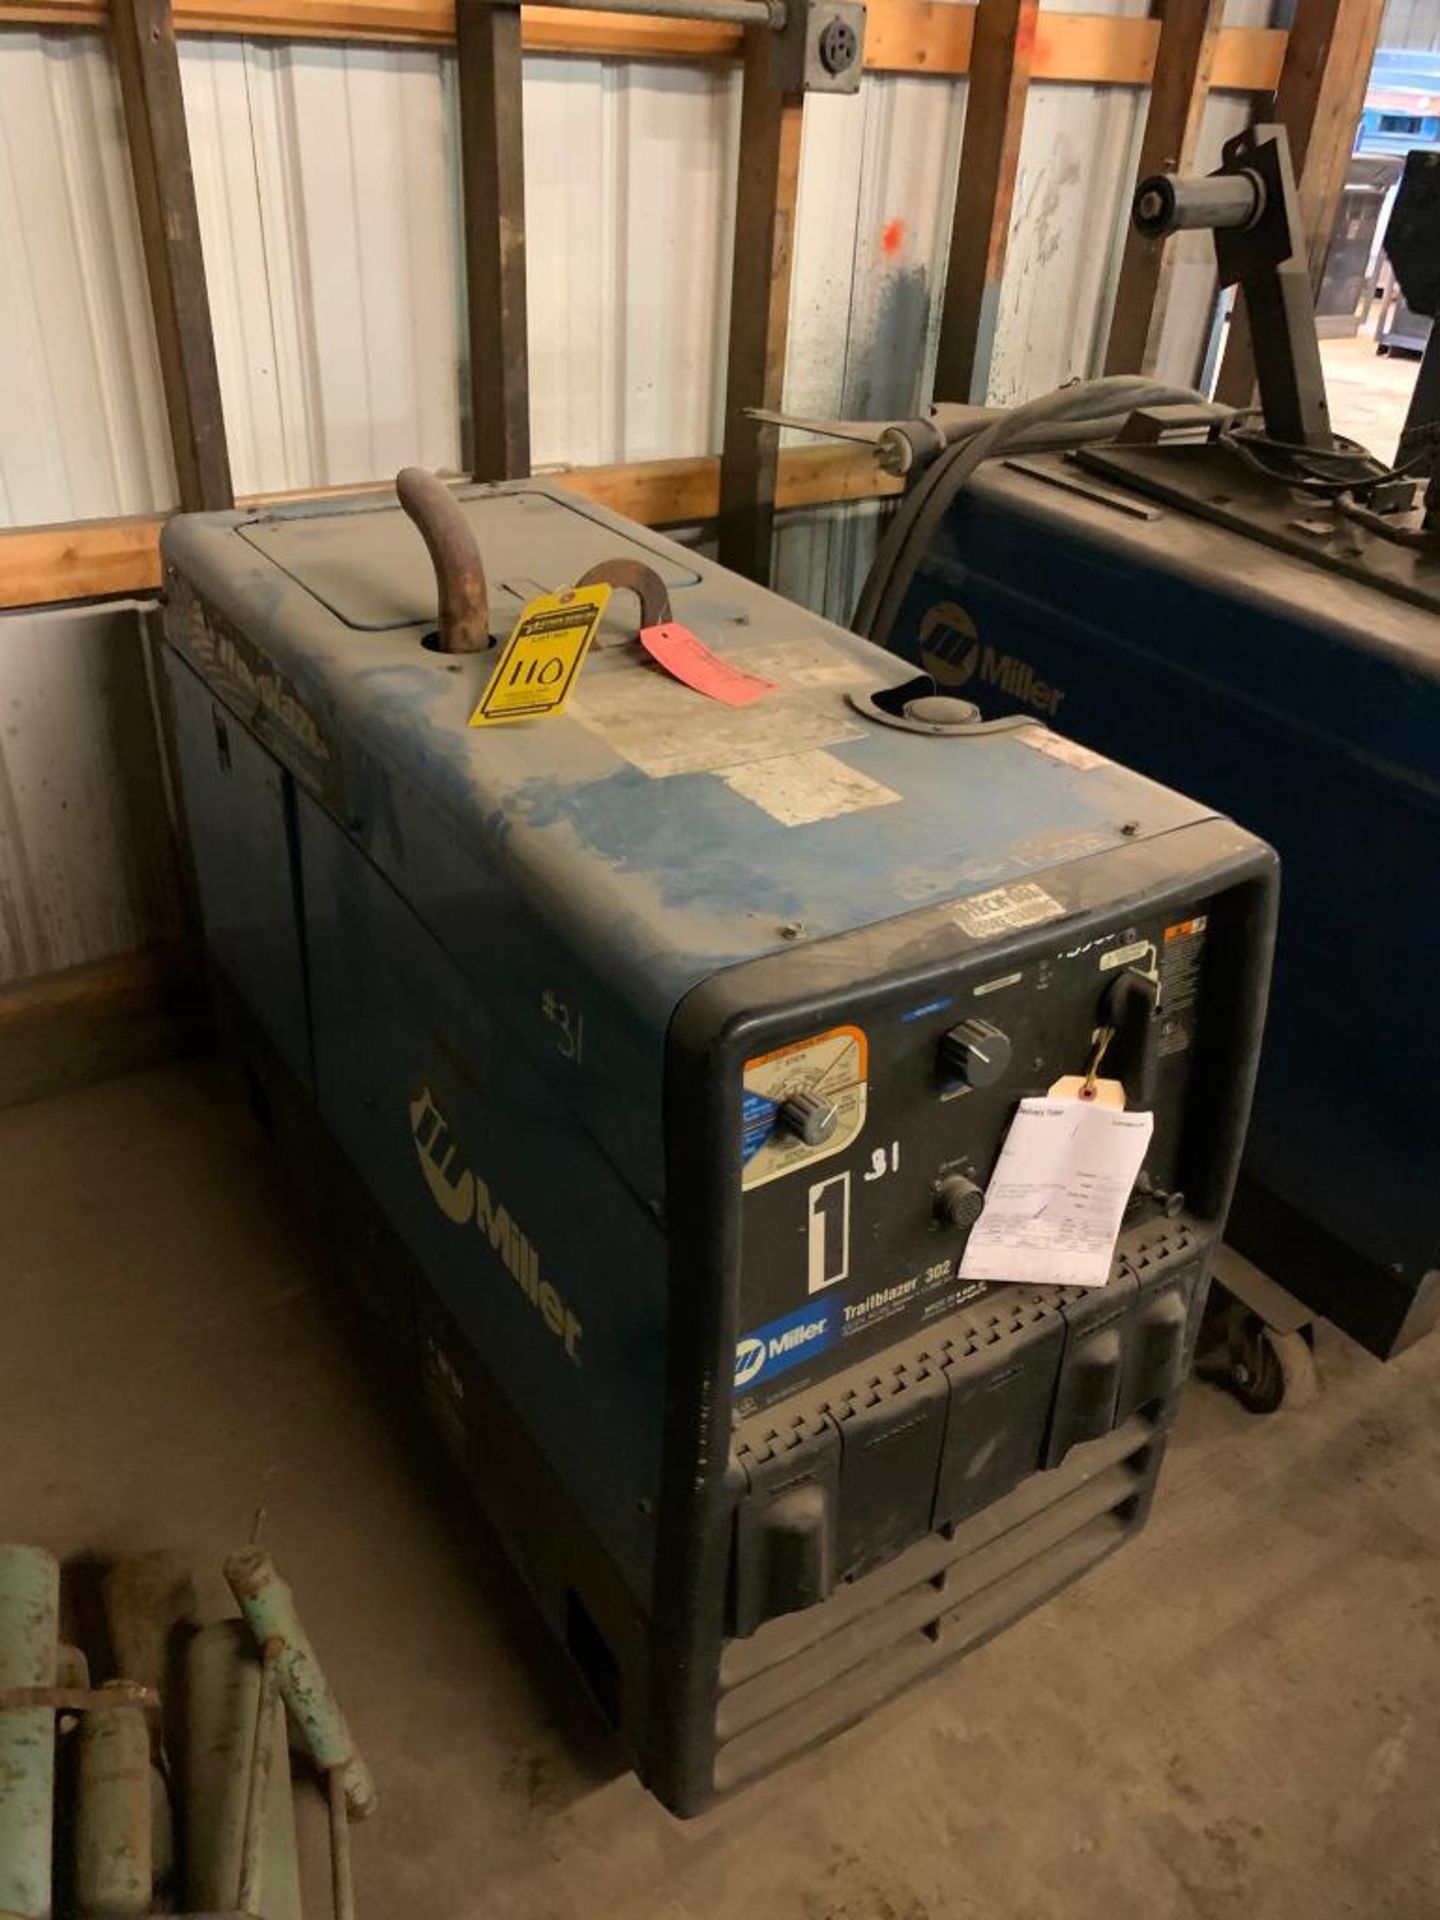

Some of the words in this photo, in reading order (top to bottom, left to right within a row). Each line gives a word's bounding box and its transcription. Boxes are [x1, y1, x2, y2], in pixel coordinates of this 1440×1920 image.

[509, 657, 564, 686] 110
[980, 646, 1062, 717] Miller
[475, 1175, 582, 1366] Miller
[843, 1277, 918, 1321] Trailblazer
[769, 1318, 828, 1358] Miller
